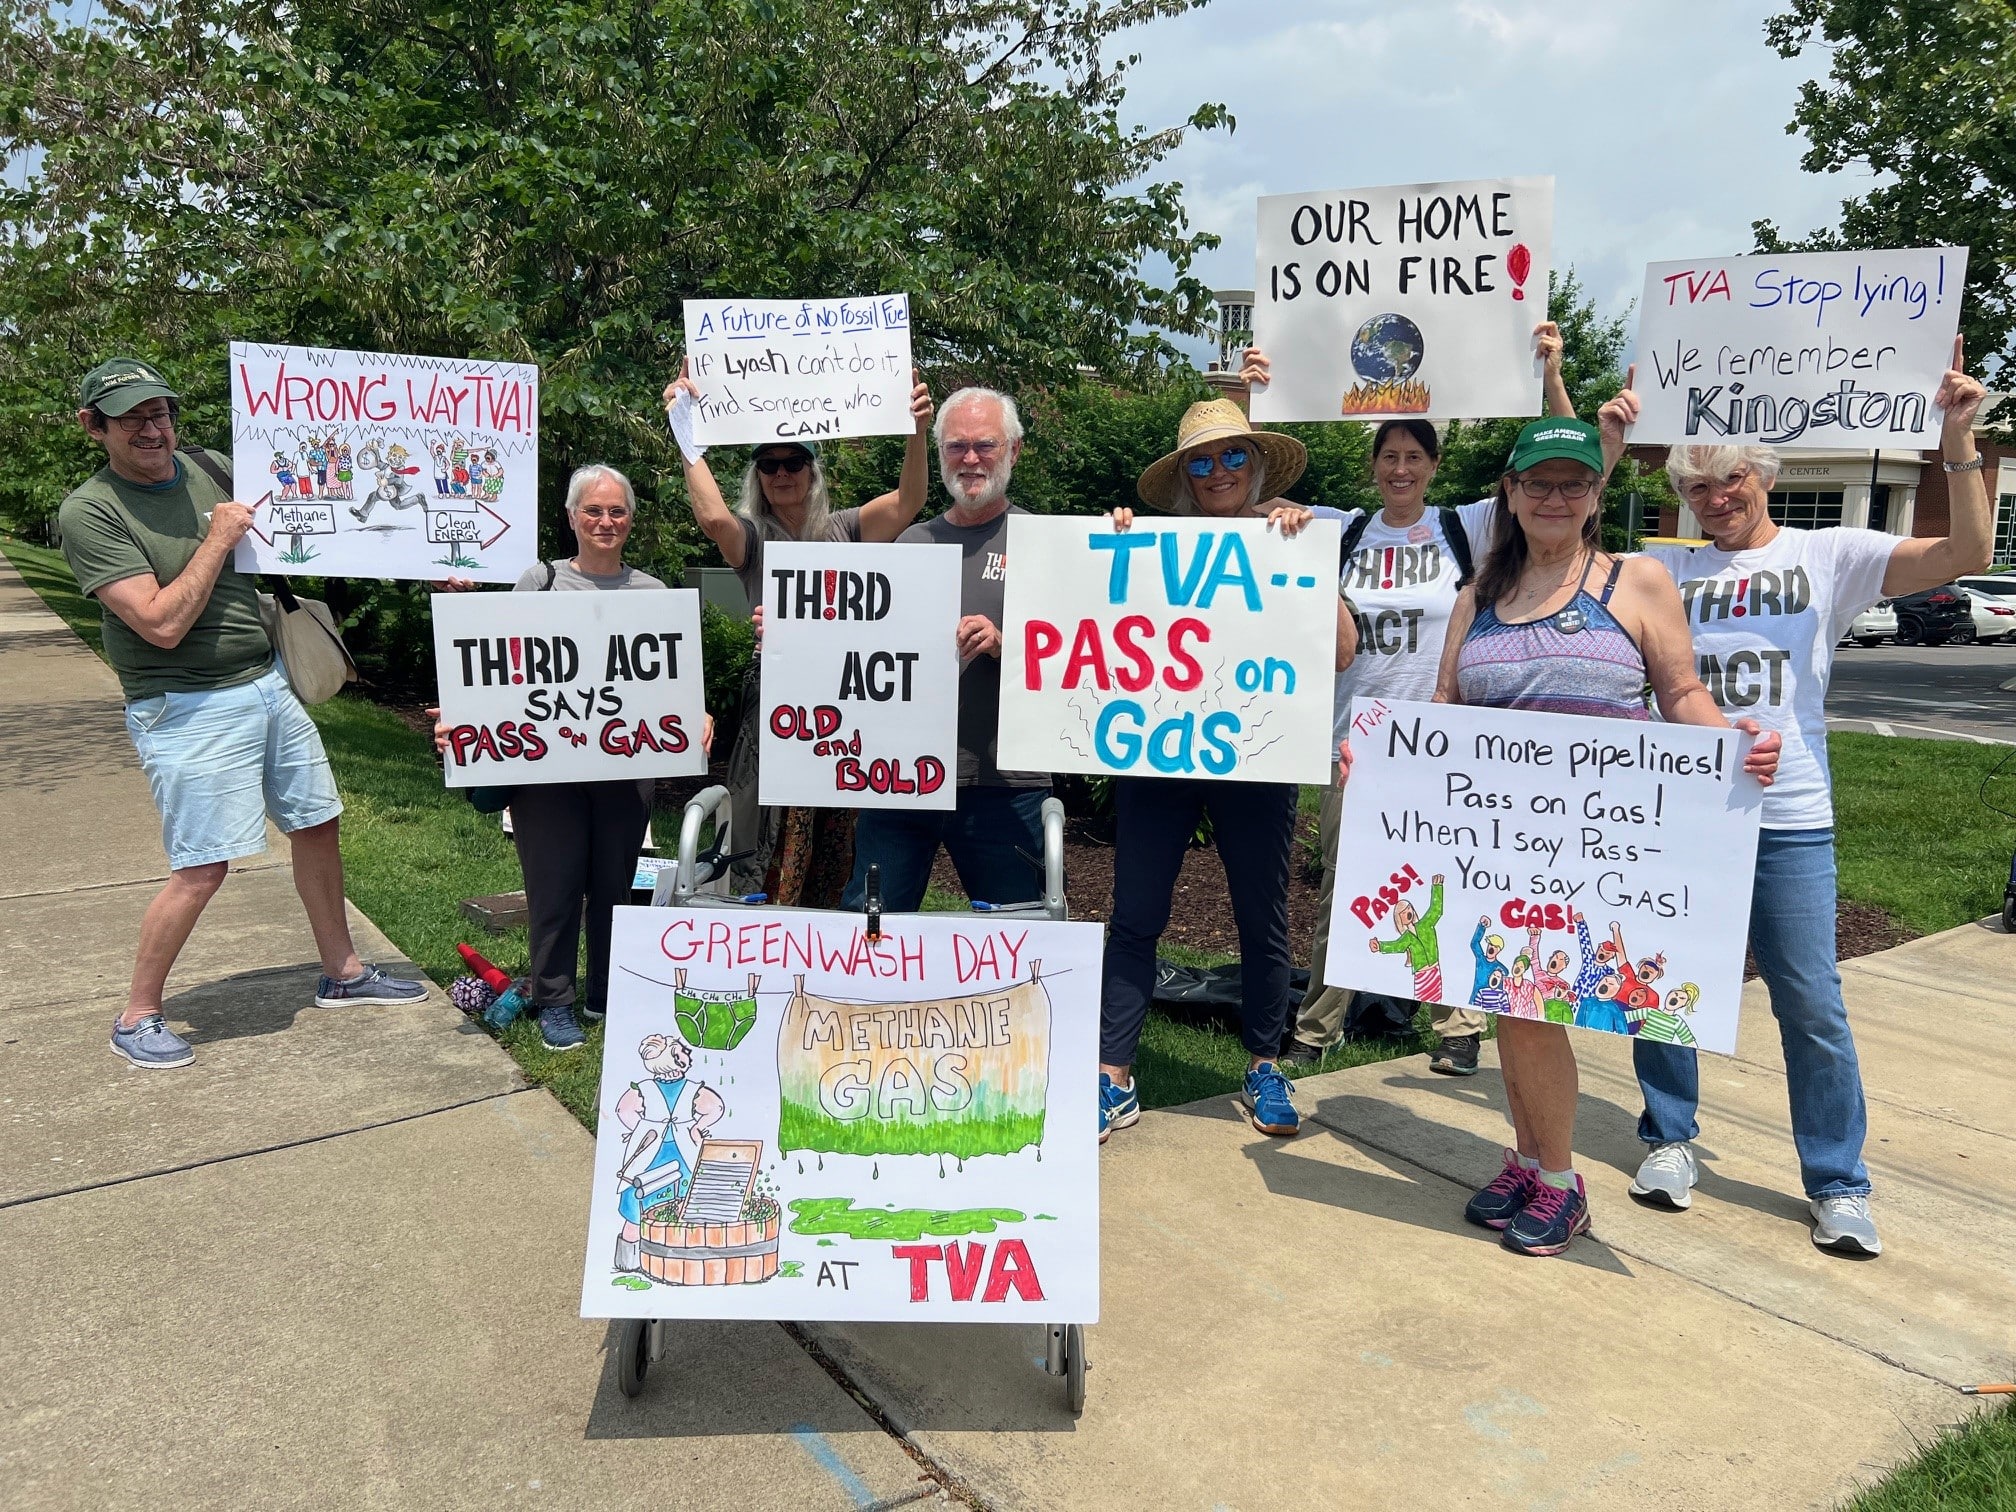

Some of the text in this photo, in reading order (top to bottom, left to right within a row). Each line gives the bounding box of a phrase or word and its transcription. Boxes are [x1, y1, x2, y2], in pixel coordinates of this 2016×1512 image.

[1291, 193, 1514, 245] OUR HOME
[1271, 243, 1531, 302] IS ON FIRE!
[1664, 255, 1943, 327] TVA Stop lying!
[699, 313, 713, 335] A
[722, 306, 791, 333] Future
[796, 302, 812, 328] of
[841, 301, 879, 328] Fossil
[882, 296, 908, 327] Fuel
[695, 354, 713, 376] If
[725, 349, 789, 380] Lyash
[849, 343, 874, 372] do
[881, 350, 900, 377] it,
[1653, 336, 1896, 389] We remember
[240, 363, 532, 436] WRONG WAY TVA!
[699, 384, 882, 423] Find someone who
[1685, 379, 1926, 443] Kingston
[777, 417, 840, 437] CAN!
[1533, 428, 1587, 438] MAKE AMERICA
[1790, 467, 1830, 476] CENTER
[269, 506, 328, 524] Methane
[285, 522, 313, 533] GAS
[435, 512, 475, 530] Clean
[435, 529, 481, 541] ENERGY
[771, 570, 891, 621] TH!RD
[1680, 565, 1810, 626] TH!RD
[1024, 615, 1296, 694] PASS on
[1355, 609, 1424, 655] ACT
[453, 633, 682, 687] TH!RD ACT
[839, 651, 919, 701] ACT
[524, 686, 623, 721] SAYS
[769, 704, 842, 741] OLD
[1352, 700, 1392, 736] TVA!
[450, 721, 548, 766] PASS
[600, 715, 689, 758] GAS
[813, 729, 862, 757] and
[1095, 699, 1241, 775] Gas
[1475, 731, 1553, 766] more
[1570, 734, 1723, 780] pipelines!
[836, 755, 945, 798] BOLD
[1446, 772, 1663, 827] Pass on Gas!
[1382, 811, 1479, 848] When
[1492, 819, 1500, 848] I
[1514, 831, 1563, 868] say
[1349, 862, 1425, 929] PASS!
[1455, 855, 1688, 919] You say GAS!
[1500, 897, 1576, 934] GAS!
[660, 920, 1029, 984] GREENWASH DAY
[803, 997, 1011, 1052] METHANE
[819, 1053, 973, 1120] GAS
[816, 1260, 860, 1290] AT
[891, 1239, 1048, 1303] TVA
